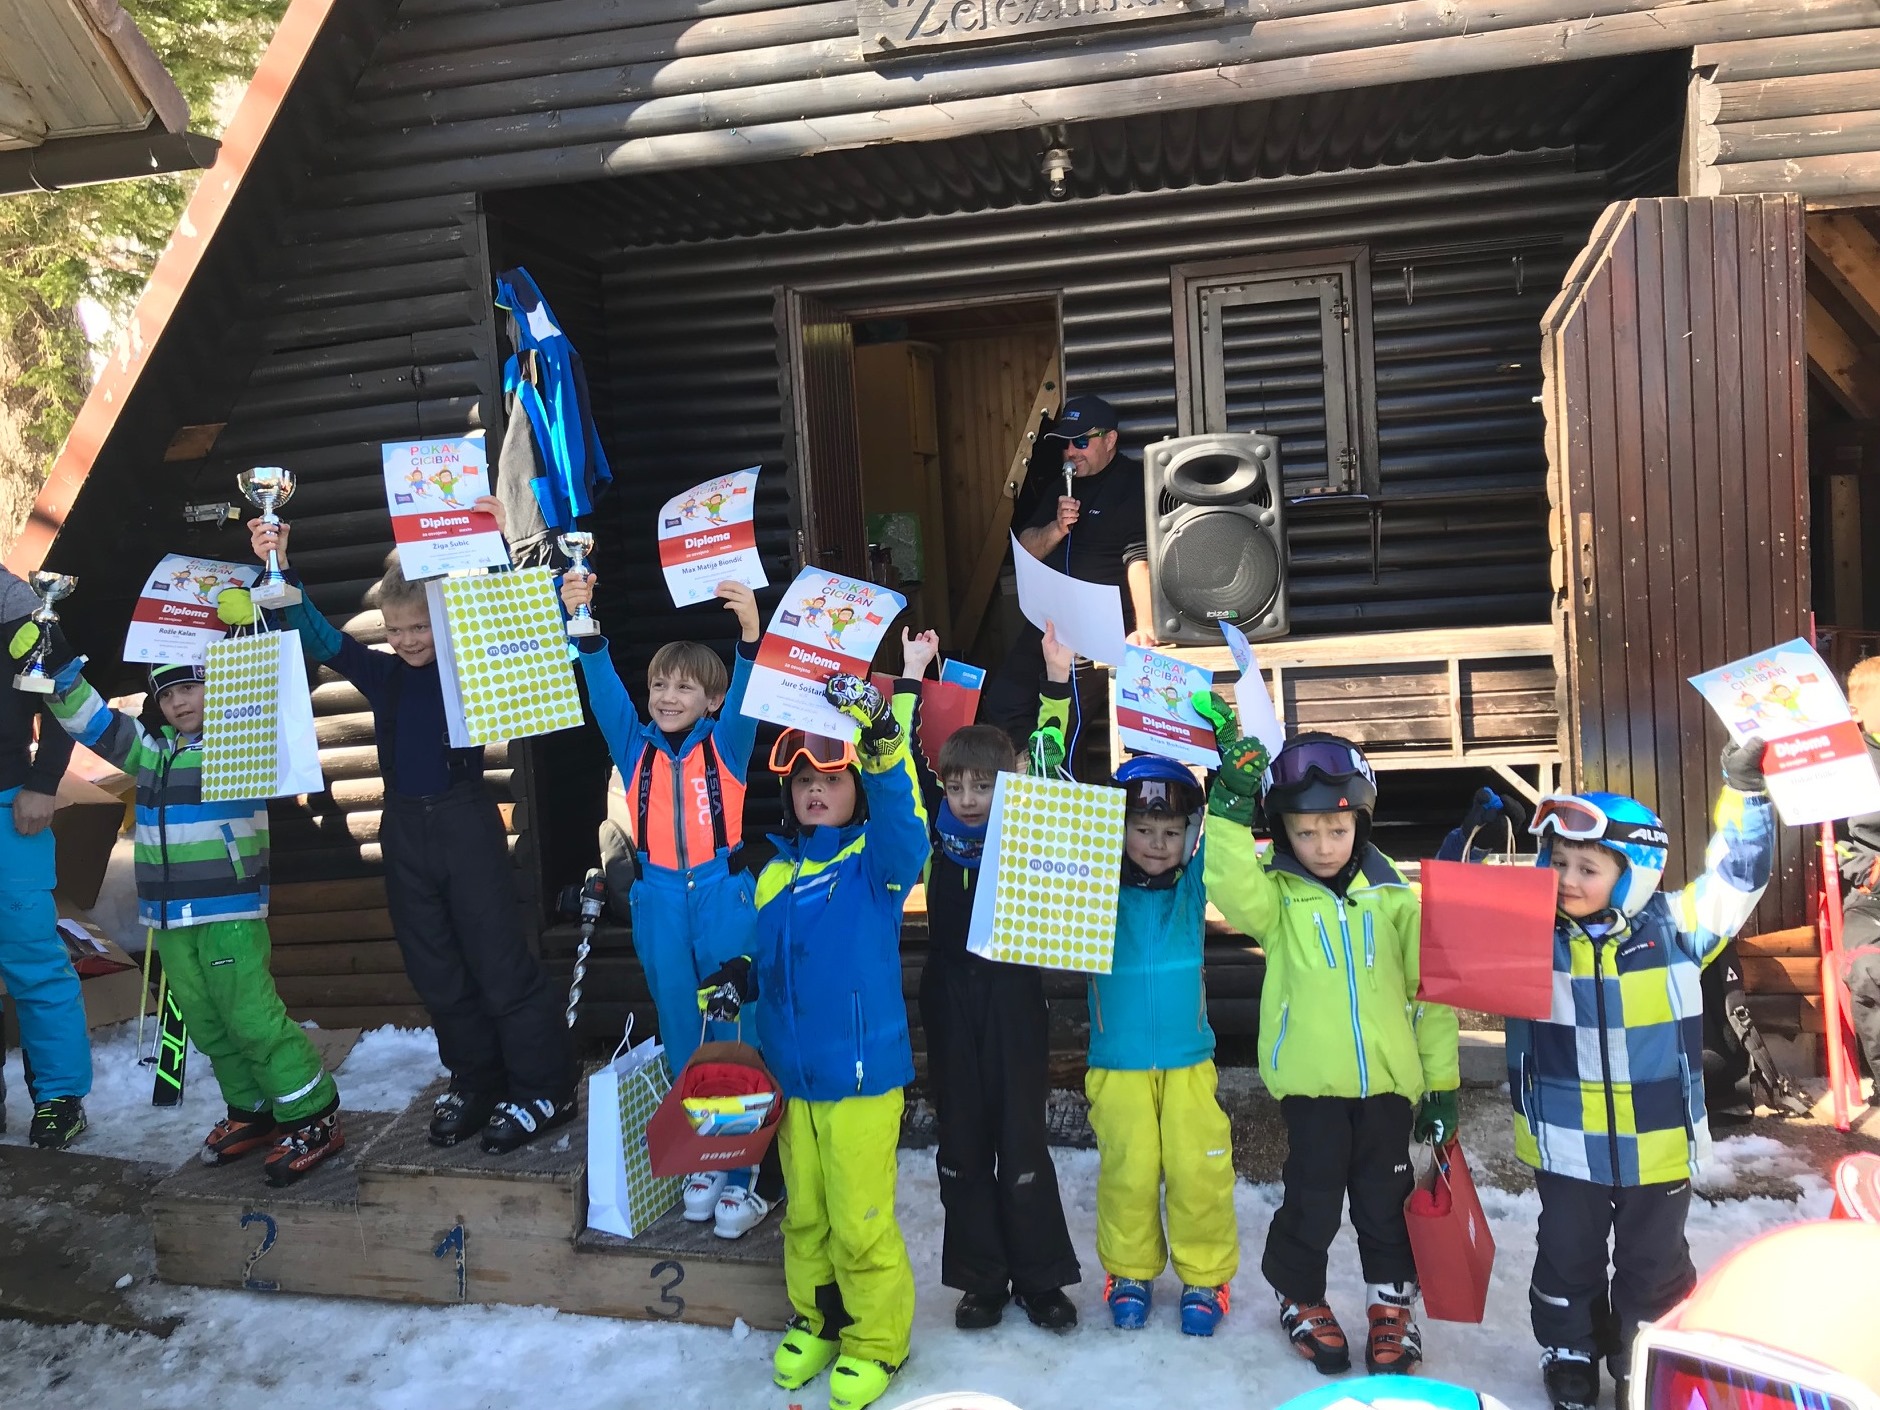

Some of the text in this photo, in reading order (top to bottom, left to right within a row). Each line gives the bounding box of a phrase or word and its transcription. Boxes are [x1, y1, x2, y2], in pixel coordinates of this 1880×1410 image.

[411, 455, 460, 466] CICIBAN
[420, 515, 470, 529] Diploma
[685, 531, 731, 550] Diploma
[697, 562, 718, 573] Matija
[821, 586, 874, 608] CICIBAN
[826, 577, 877, 600] POKAL
[162, 604, 210, 619] Diploma
[488, 640, 539, 656] monea
[788, 645, 841, 672] Diploma
[1144, 653, 1186, 675] POKAL
[781, 679, 798, 689] Jure
[1142, 665, 1187, 686] CICIBAN
[1731, 666, 1788, 691] CICIBAN
[1142, 716, 1191, 737] Diploma
[1773, 735, 1831, 759] Diploma
[690, 777, 712, 826] poc
[1030, 859, 1089, 877] monea
[240, 1211, 687, 1320] 2 1 3
